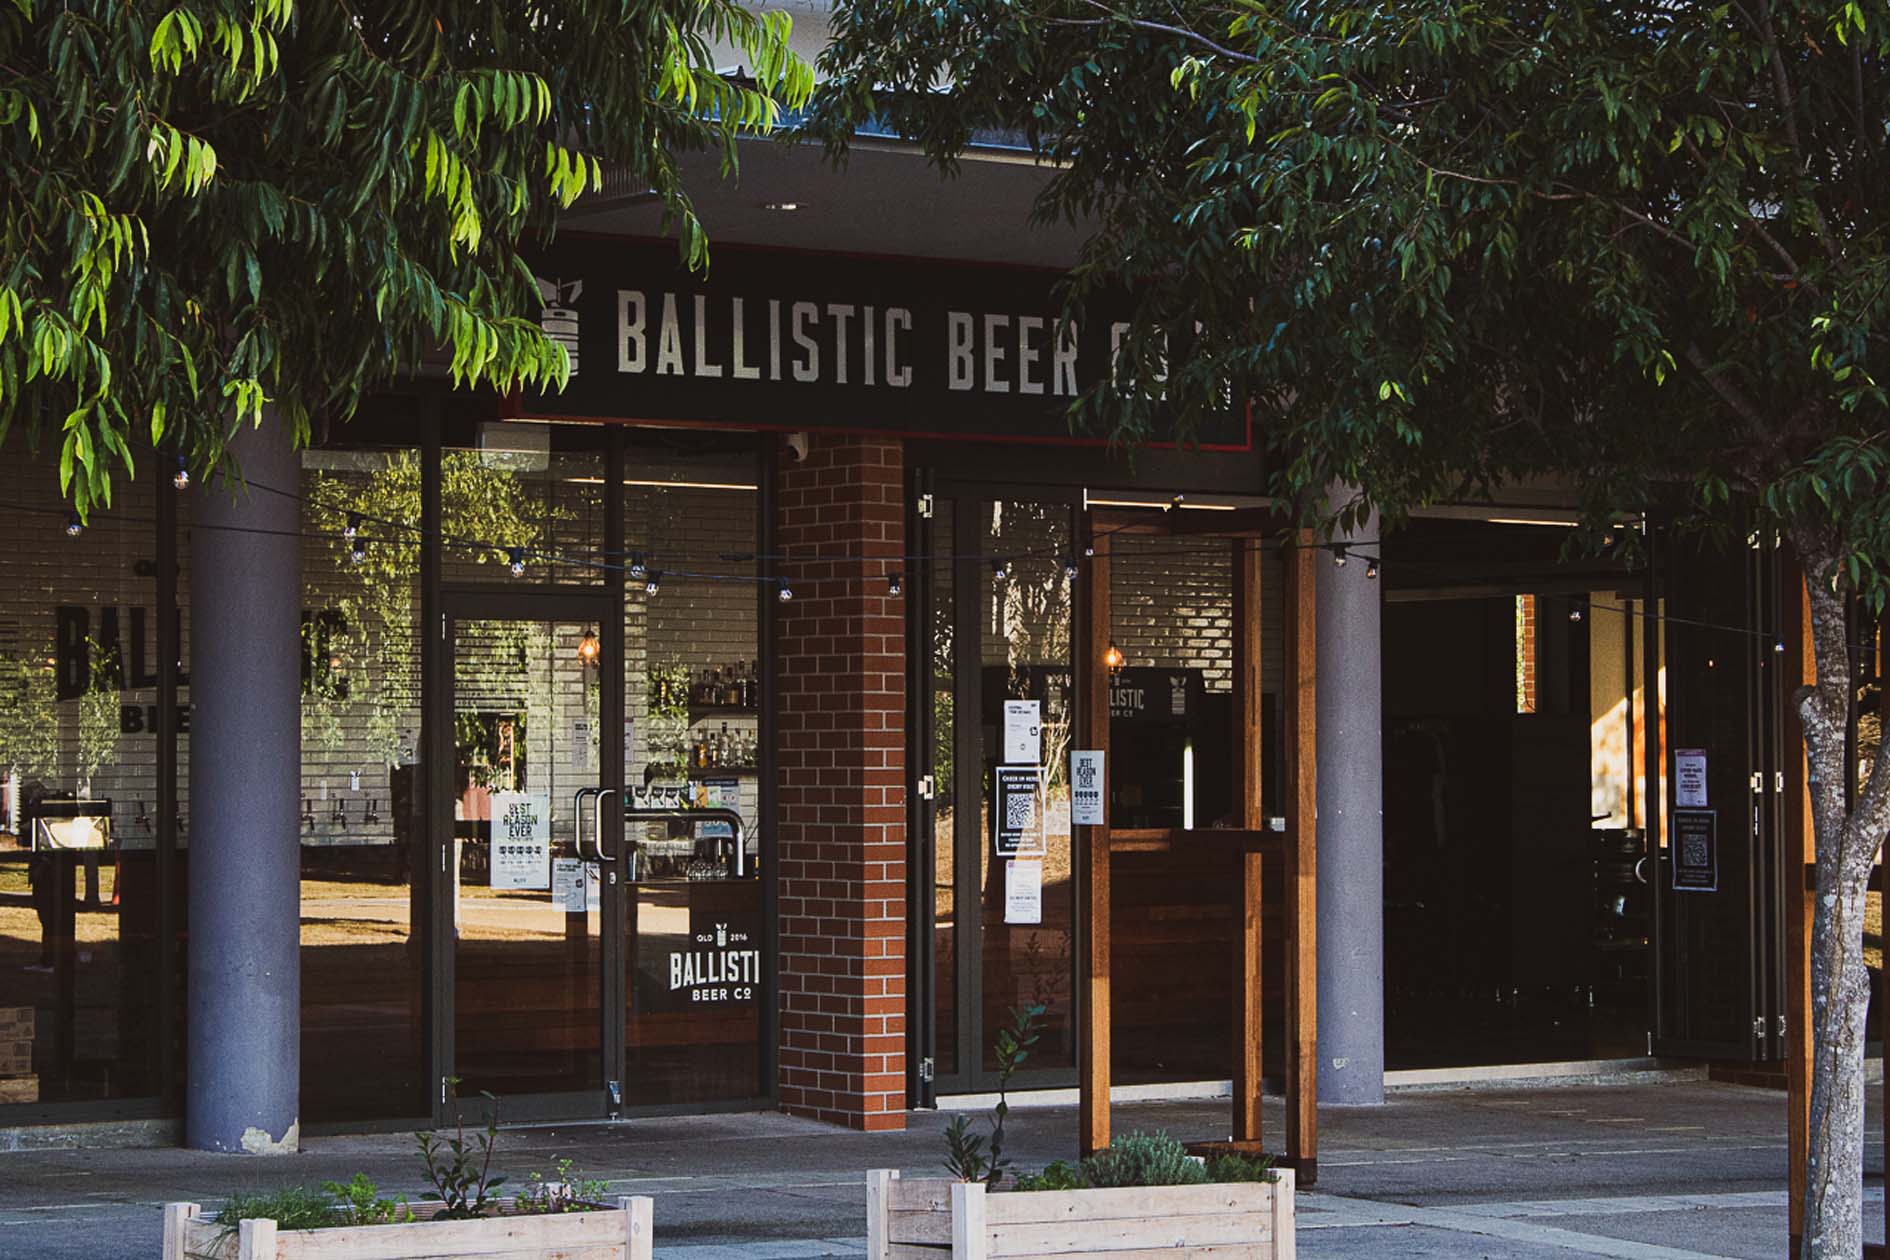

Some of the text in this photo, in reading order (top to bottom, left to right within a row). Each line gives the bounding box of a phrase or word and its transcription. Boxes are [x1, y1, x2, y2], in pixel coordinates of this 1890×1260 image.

[617, 289, 913, 387] BALLISTIC
[948, 311, 1079, 397] BEER
[508, 803, 532, 815] BEST
[503, 814, 538, 826] REASON
[509, 825, 533, 837] EVER
[692, 988, 728, 1001] BEER
